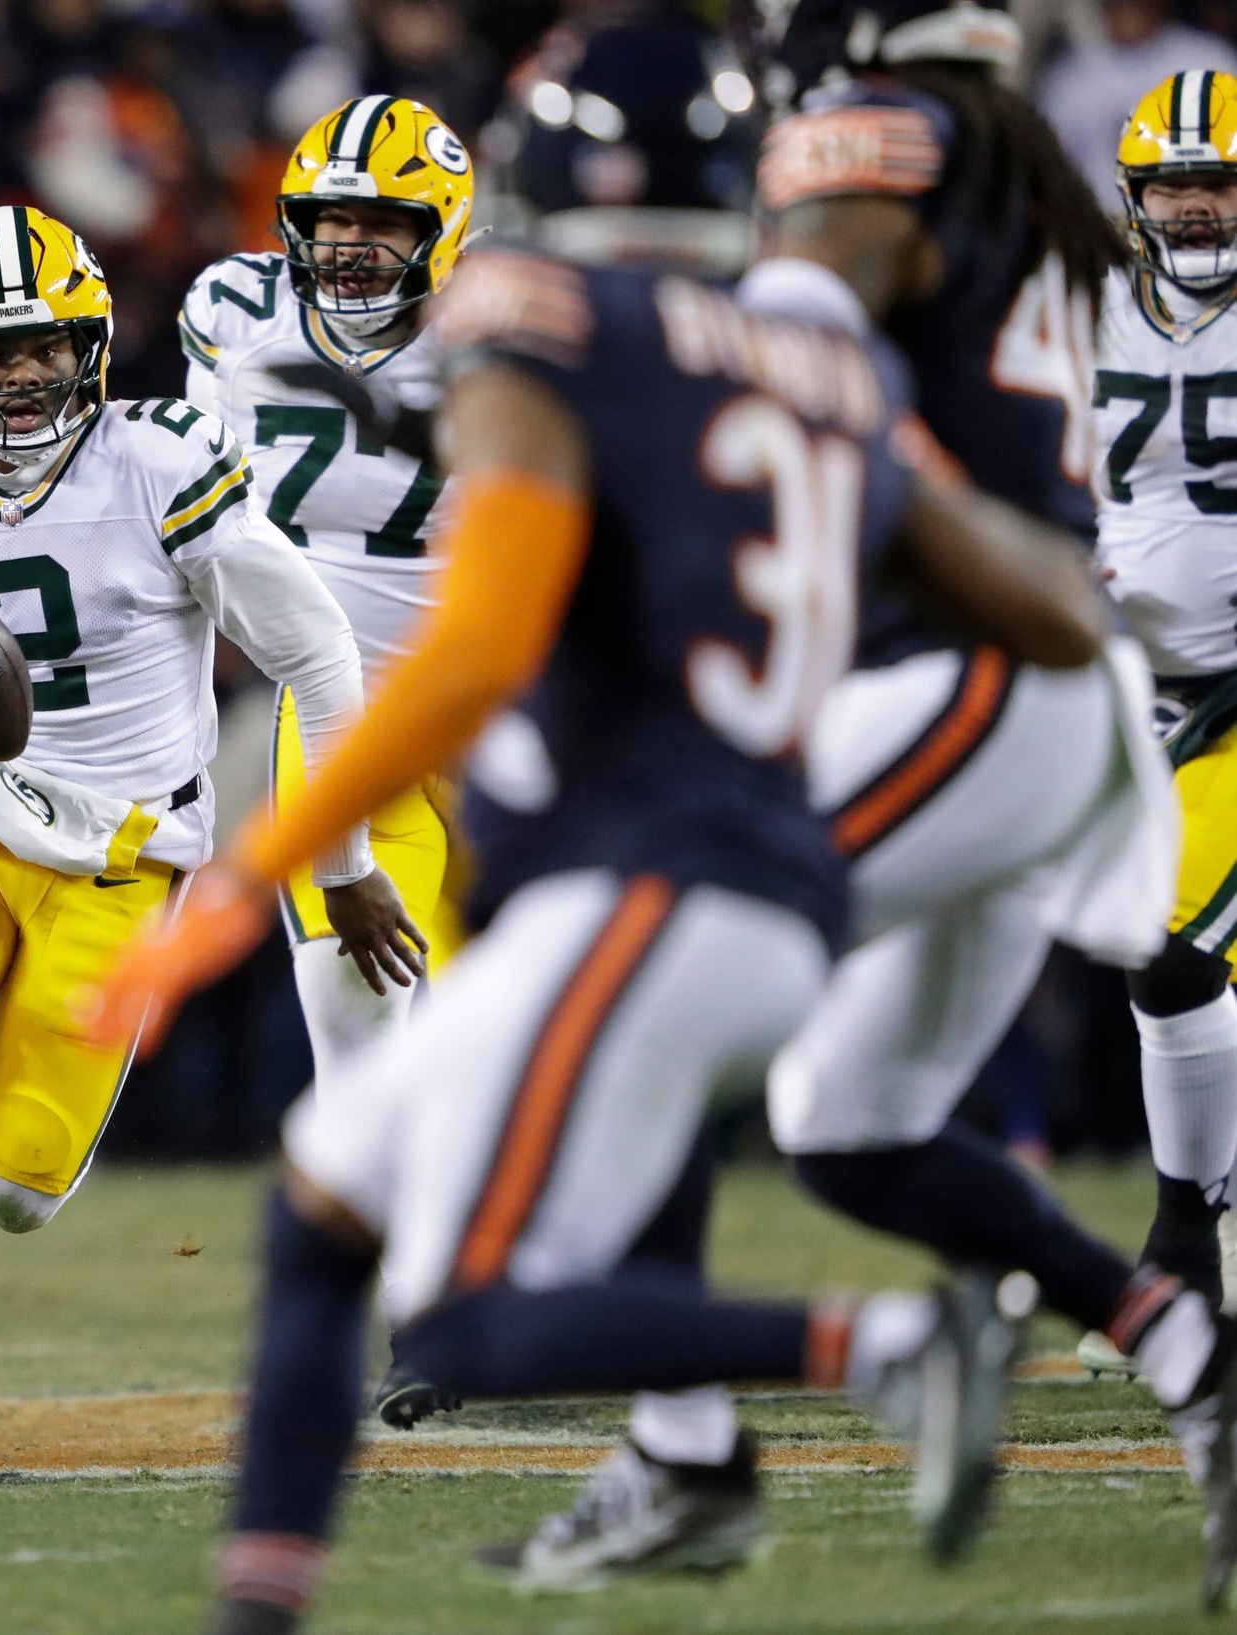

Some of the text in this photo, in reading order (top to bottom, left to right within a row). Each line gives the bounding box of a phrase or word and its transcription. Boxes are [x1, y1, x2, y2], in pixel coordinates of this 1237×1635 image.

[0, 304, 34, 319] PACKERS
[1092, 369, 1237, 515] 75
[685, 390, 863, 757] 31
